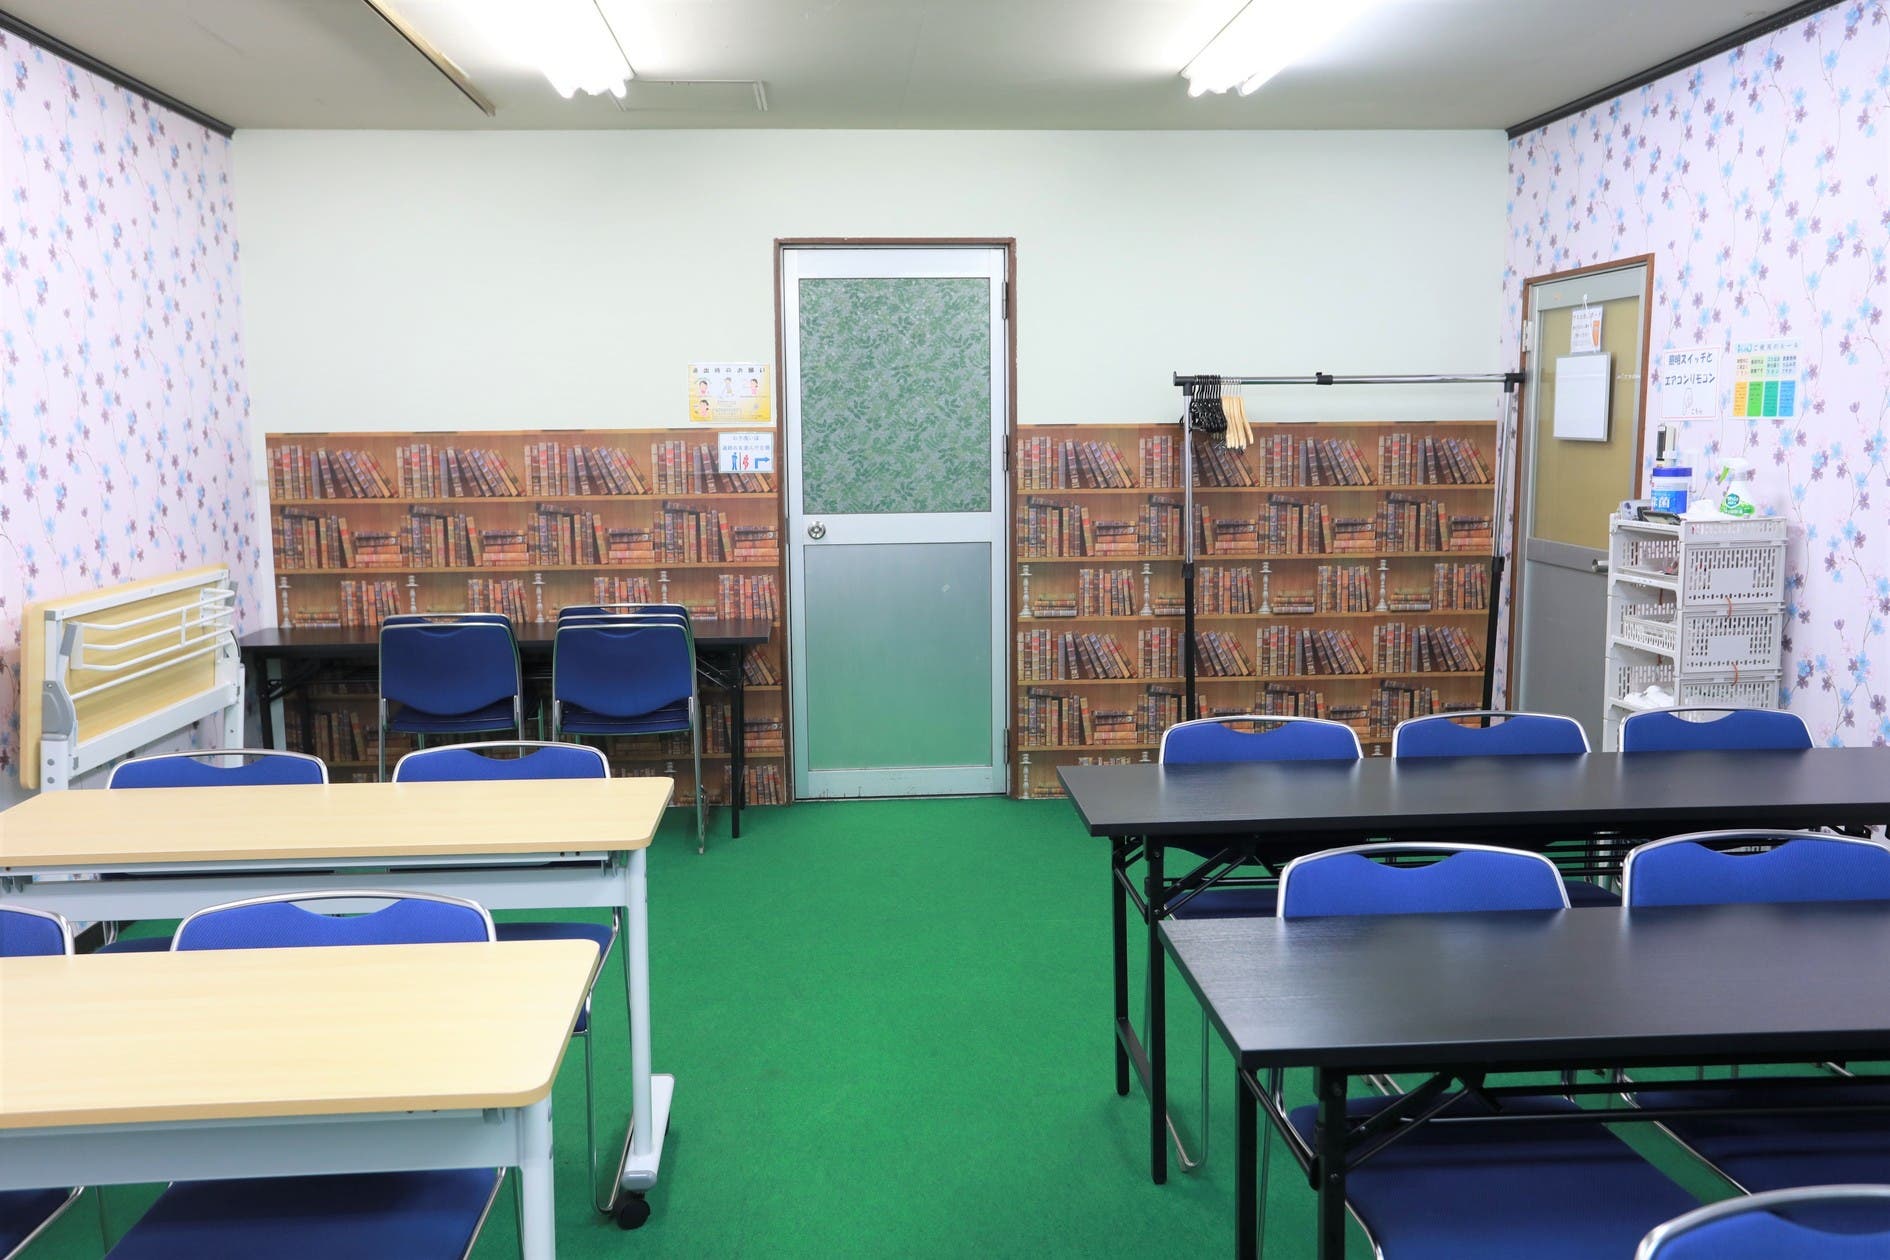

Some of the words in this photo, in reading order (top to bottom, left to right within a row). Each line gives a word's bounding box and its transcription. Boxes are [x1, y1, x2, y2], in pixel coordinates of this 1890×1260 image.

[1668, 352, 1713, 366] 照明スイッチと
[1664, 373, 1716, 386] エアコンリモコン
